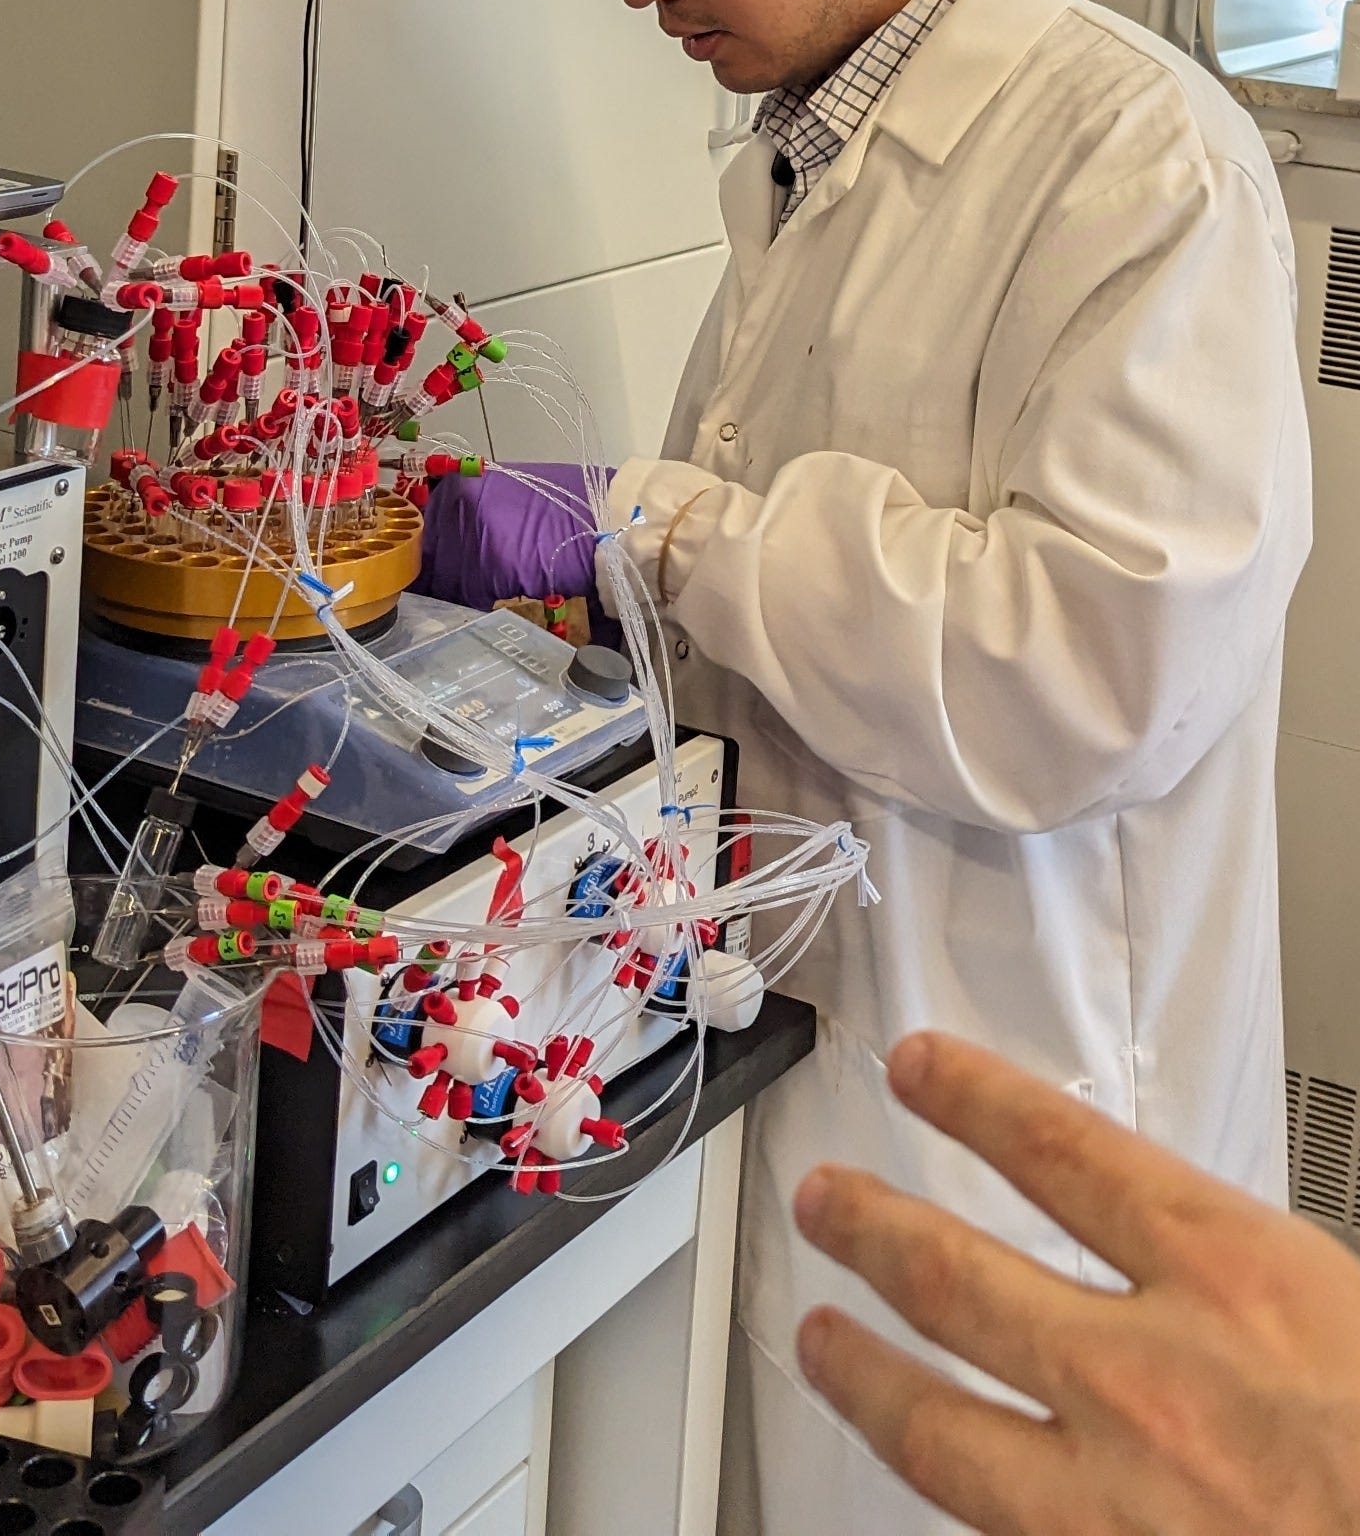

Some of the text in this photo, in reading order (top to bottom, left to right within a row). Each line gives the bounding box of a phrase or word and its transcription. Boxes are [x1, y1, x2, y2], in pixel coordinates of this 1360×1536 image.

[13, 498, 53, 519] Scientific
[9, 534, 33, 548] Pump
[8, 548, 27, 563] 1200
[587, 833, 596, 852] 3
